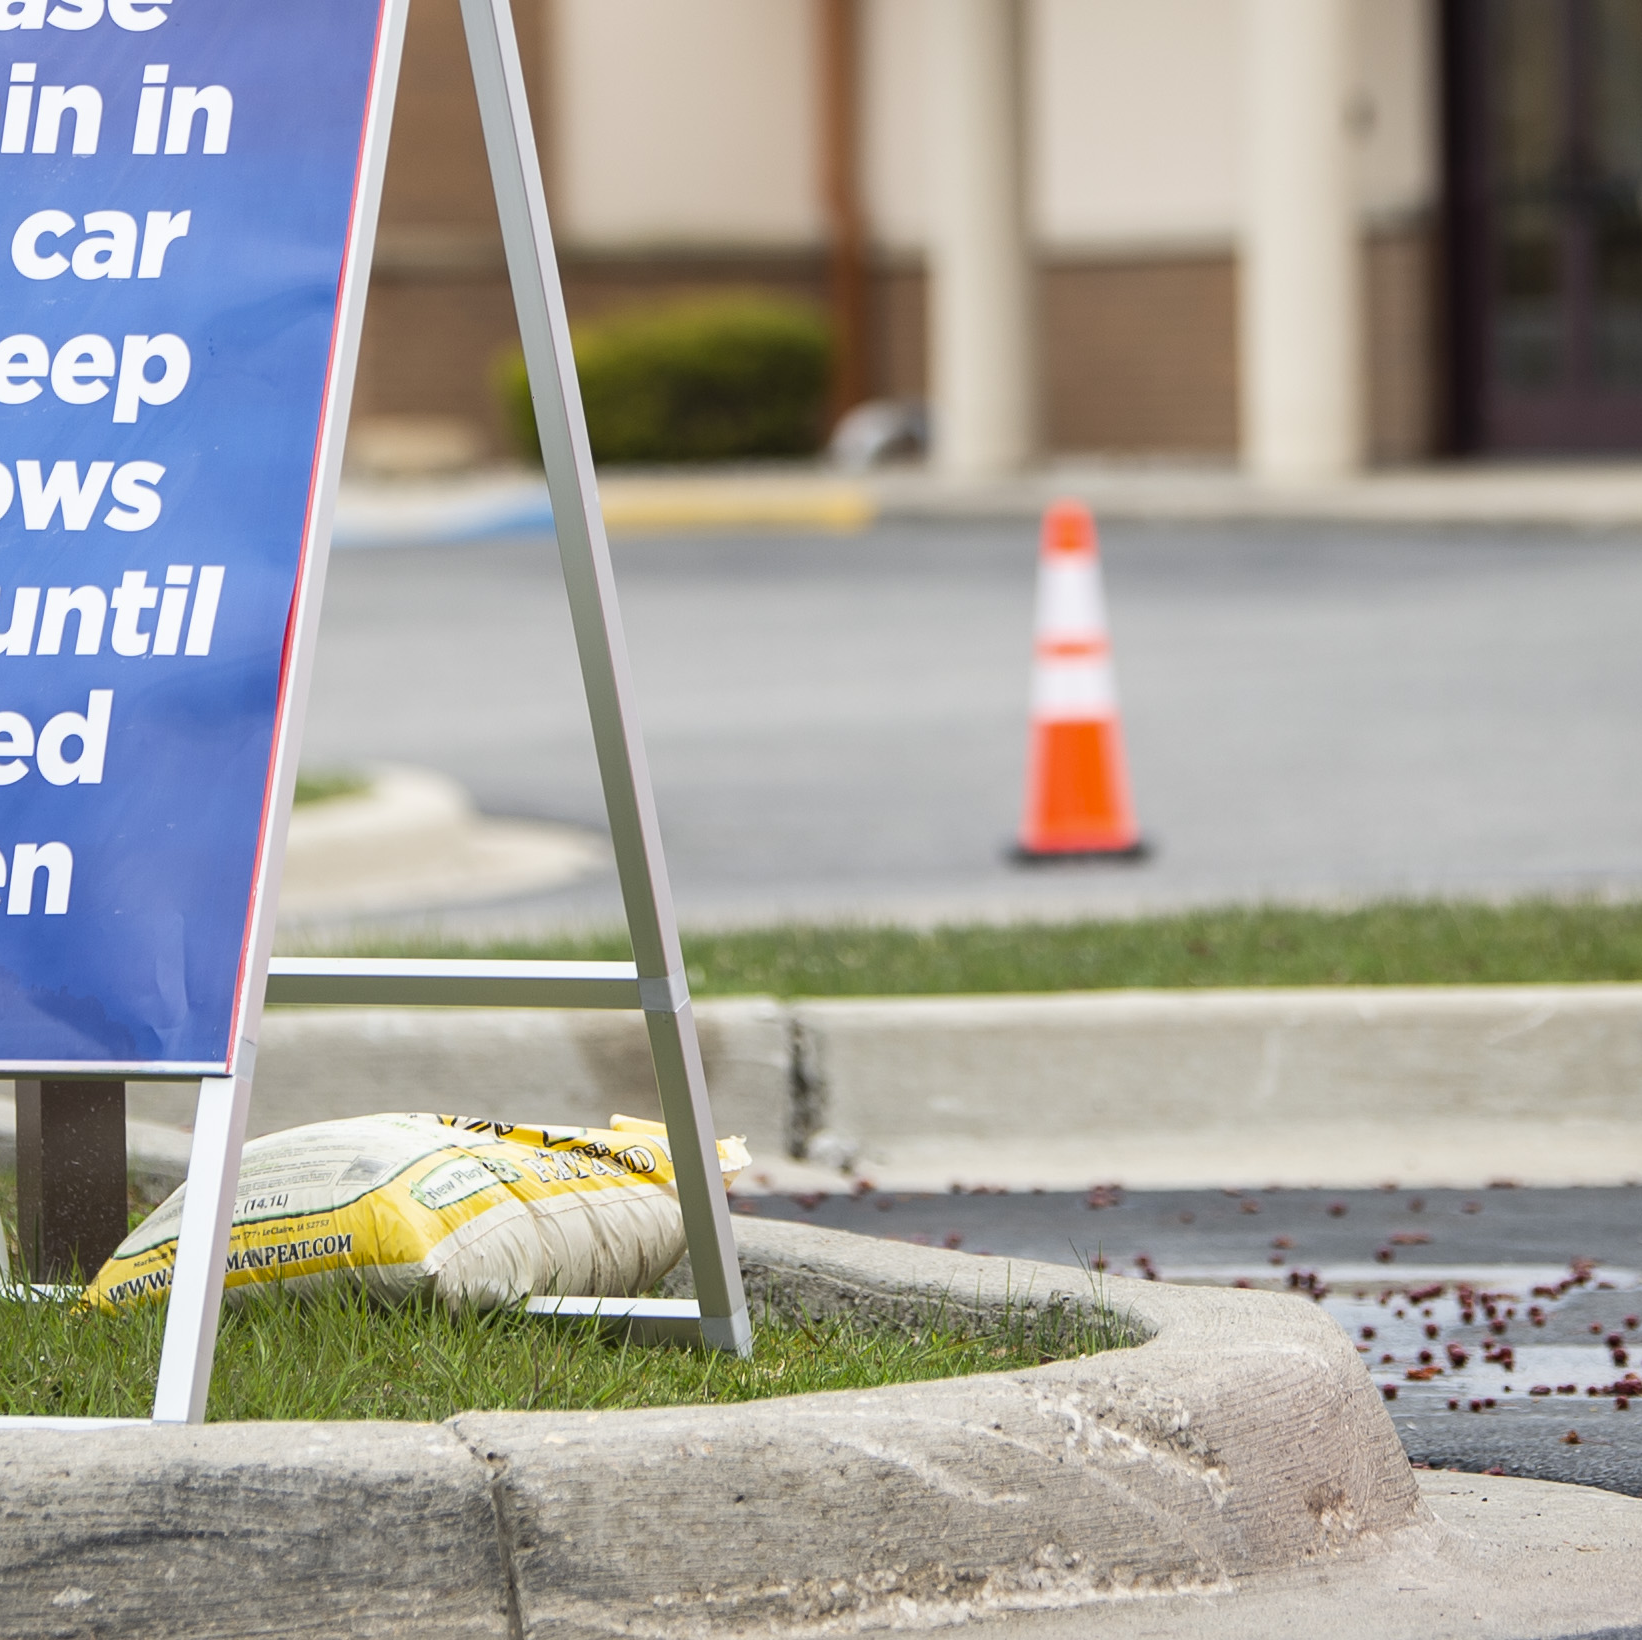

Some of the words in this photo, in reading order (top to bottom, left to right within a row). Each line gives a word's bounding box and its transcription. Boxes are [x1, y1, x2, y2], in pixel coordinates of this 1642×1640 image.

[133, 65, 233, 155] in
[11, 210, 191, 280] car
[244, 1193, 289, 1214] (14.1L)
